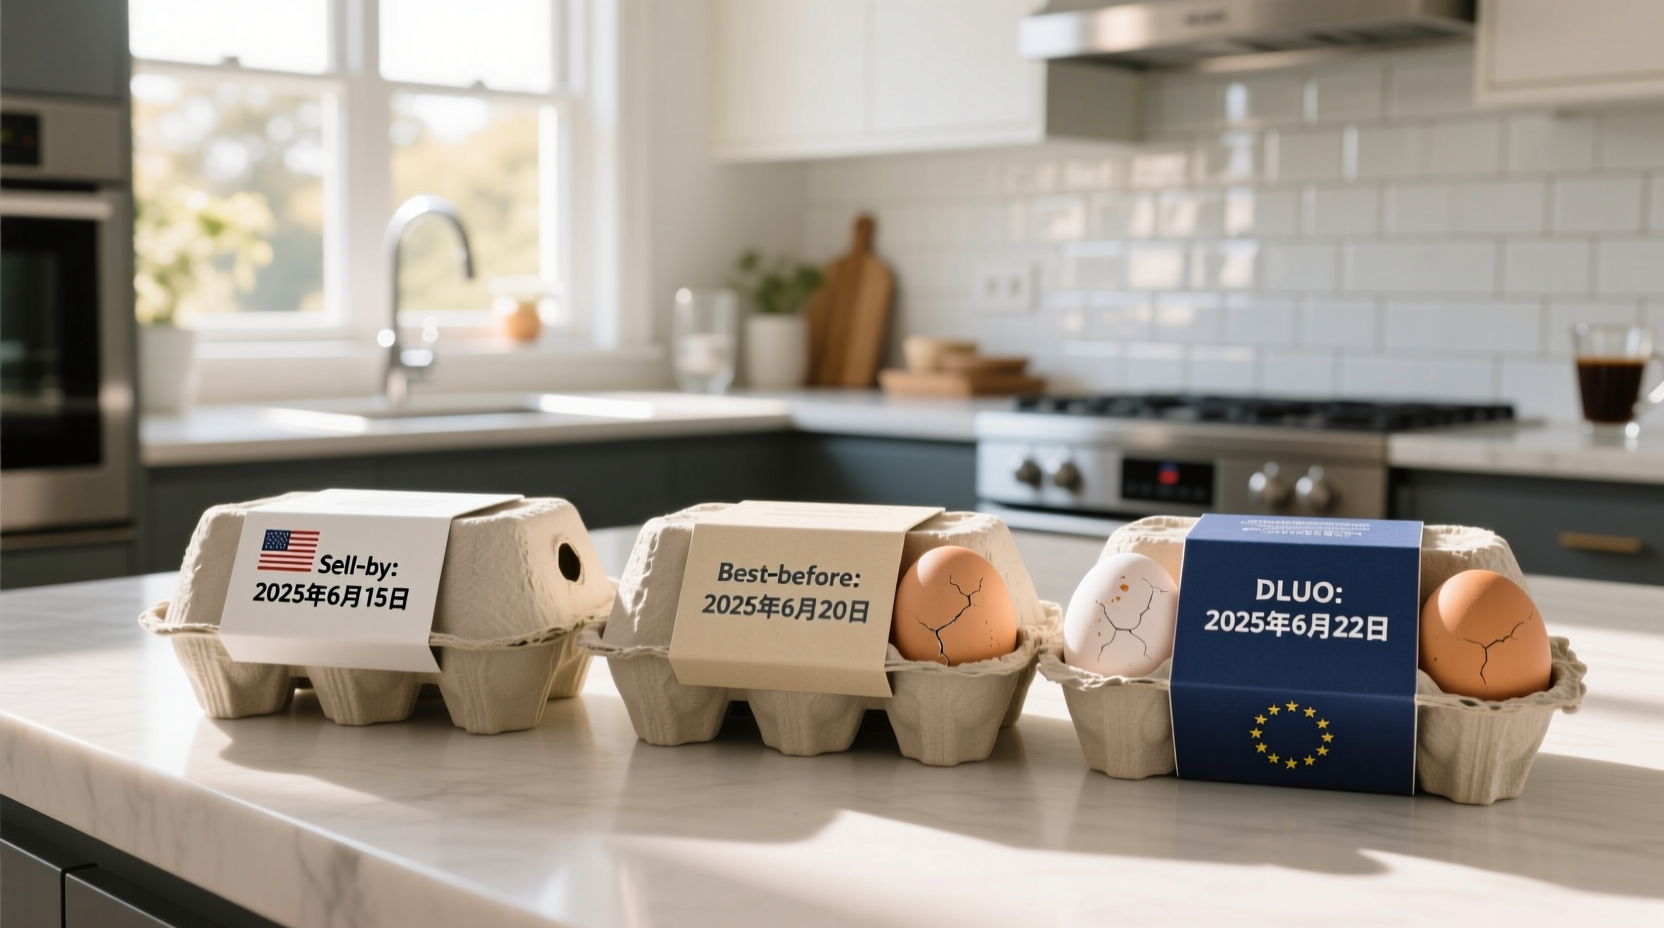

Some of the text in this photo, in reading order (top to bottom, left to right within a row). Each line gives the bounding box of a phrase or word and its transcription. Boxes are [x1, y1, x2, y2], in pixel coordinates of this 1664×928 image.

[317, 554, 398, 581] Sell-by:
[717, 562, 861, 588] Best-before:
[253, 582, 409, 611] 2025年6月15日
[1256, 579, 1343, 604] DLUO:
[702, 593, 870, 624] 2025年6月20日
[1204, 610, 1388, 641] 2025年6月22日
